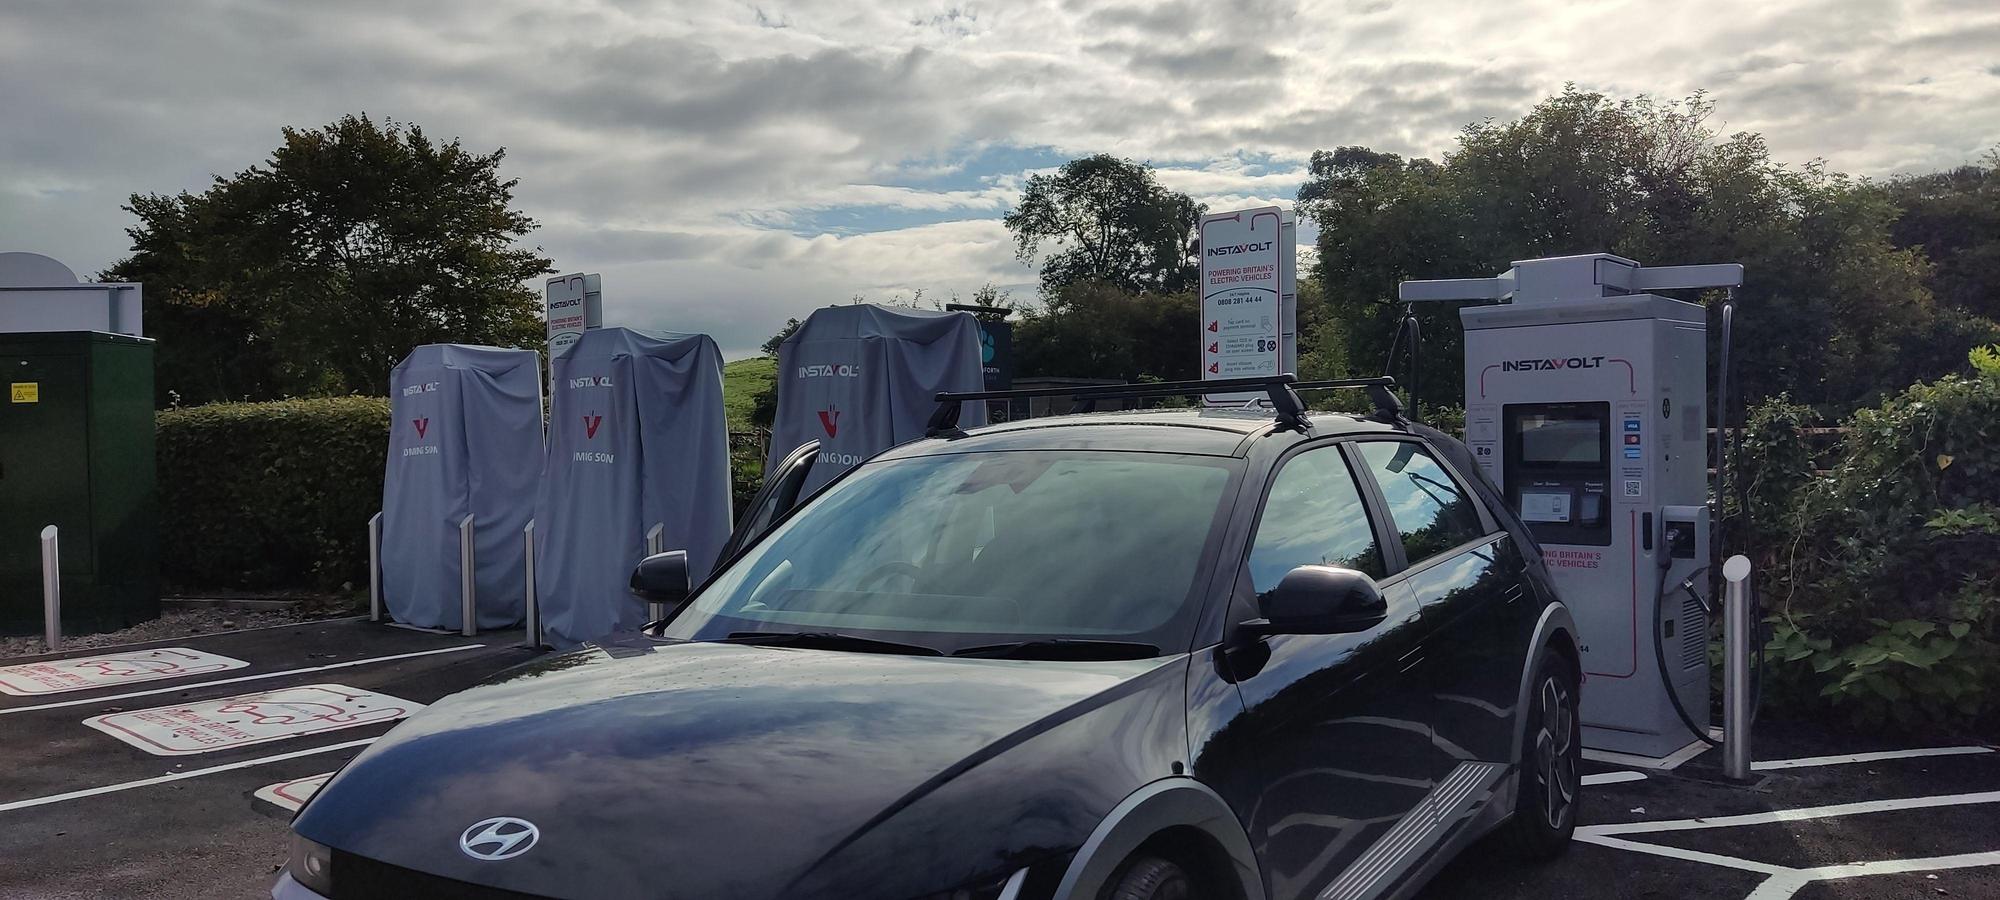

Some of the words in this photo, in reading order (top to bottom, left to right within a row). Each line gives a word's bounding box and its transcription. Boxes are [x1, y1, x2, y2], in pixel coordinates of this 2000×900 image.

[1208, 242, 1272, 256] INSTAVOLT
[1208, 268, 1241, 277] POWERING
[1243, 265, 1274, 273] BRITAIN'S
[1210, 276, 1239, 284] ELECTRIC
[1241, 273, 1271, 281] VEHICLES
[550, 298, 581, 309] INSTAVOLT
[1503, 356, 1605, 372] INSTAVOLT
[799, 365, 859, 378] INSTAVOL
[1559, 551, 1601, 560] BRITAIN'S
[1557, 560, 1599, 569] VEHICLES
